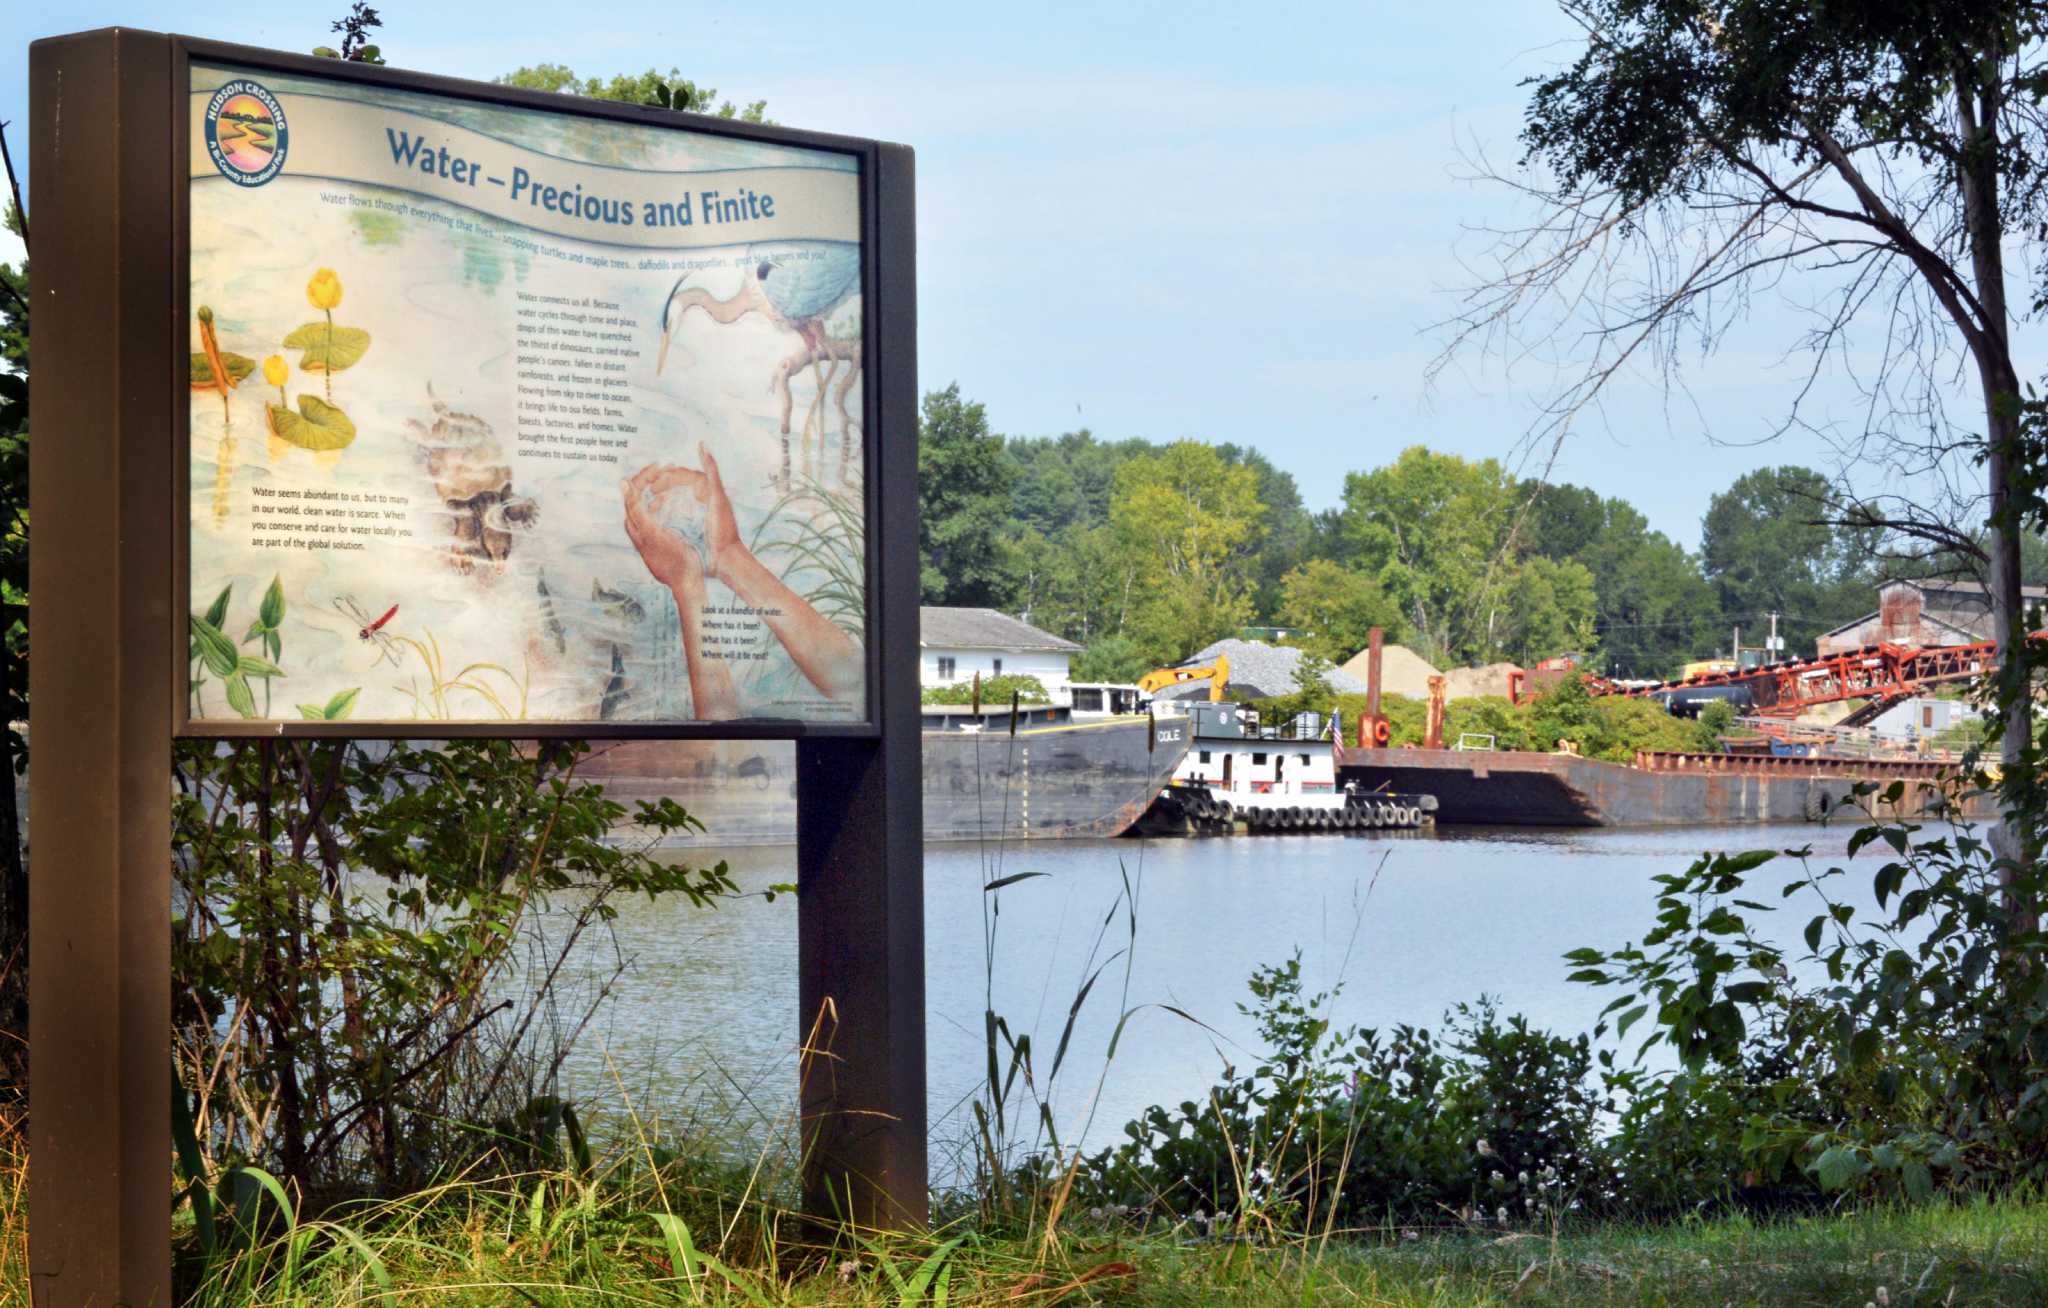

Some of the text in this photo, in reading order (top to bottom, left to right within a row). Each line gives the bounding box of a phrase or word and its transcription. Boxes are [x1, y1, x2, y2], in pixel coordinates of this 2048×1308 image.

[208, 83, 285, 130] HUDSON CROSSING
[386, 128, 480, 187] Water
[511, 166, 635, 226] Precious
[643, 192, 693, 227] and
[701, 188, 775, 225] Finite
[320, 191, 347, 205] Water
[349, 194, 372, 207] flows
[410, 207, 454, 229] everything
[455, 218, 473, 231] that
[503, 234, 540, 254] snapping
[541, 245, 567, 260] turtles
[569, 251, 583, 263] and
[585, 256, 608, 270] maple
[638, 258, 669, 271] daffodils
[672, 259, 685, 270] and
[517, 291, 538, 302] Water
[539, 295, 570, 306] connects
[593, 299, 620, 310] Because
[517, 309, 536, 318] water
[538, 310, 559, 321] cycles
[560, 311, 587, 324] through
[589, 315, 604, 324] time
[606, 316, 618, 325] and
[517, 323, 536, 334] drops
[538, 324, 546, 333] of
[562, 328, 581, 337] water
[583, 329, 598, 339] have
[600, 331, 632, 343] quenched
[517, 338, 529, 347] the
[530, 339, 550, 350] thirst
[551, 341, 560, 350] of
[596, 346, 618, 356] carried
[620, 348, 640, 358] native
[575, 358, 593, 369] fallen
[595, 361, 601, 369] in
[603, 360, 626, 371] distant
[558, 373, 570, 383] and
[572, 373, 593, 384] frozen
[518, 384, 544, 397] Flowing
[546, 386, 562, 397] from
[563, 387, 575, 399] sky
[577, 390, 584, 398] to
[585, 390, 600, 400] river
[602, 392, 610, 400] to
[525, 401, 546, 413] brings
[548, 403, 559, 412] life
[560, 404, 567, 412] to
[569, 406, 581, 415] our
[578, 421, 590, 430] and
[617, 423, 638, 433] Water
[518, 431, 628, 448] brought the first people here and
[518, 449, 552, 458] continues
[553, 450, 560, 458] to
[563, 451, 587, 460] sustain
[589, 453, 598, 461] us
[252, 486, 276, 497] Water
[278, 489, 301, 498] seems
[303, 489, 338, 501] abundant
[341, 492, 349, 501] to
[364, 493, 377, 503] but
[379, 494, 387, 503] to
[389, 496, 409, 506] many
[252, 504, 260, 513] in
[262, 505, 275, 514] our
[303, 505, 323, 516] clean
[325, 508, 346, 517] water
[349, 509, 355, 518] is
[384, 510, 406, 520] When
[252, 521, 412, 538] you conserve and care for water locally you
[252, 537, 264, 546] are
[266, 538, 281, 548] part
[283, 537, 292, 547] of
[293, 538, 305, 547] the
[308, 538, 330, 550] global
